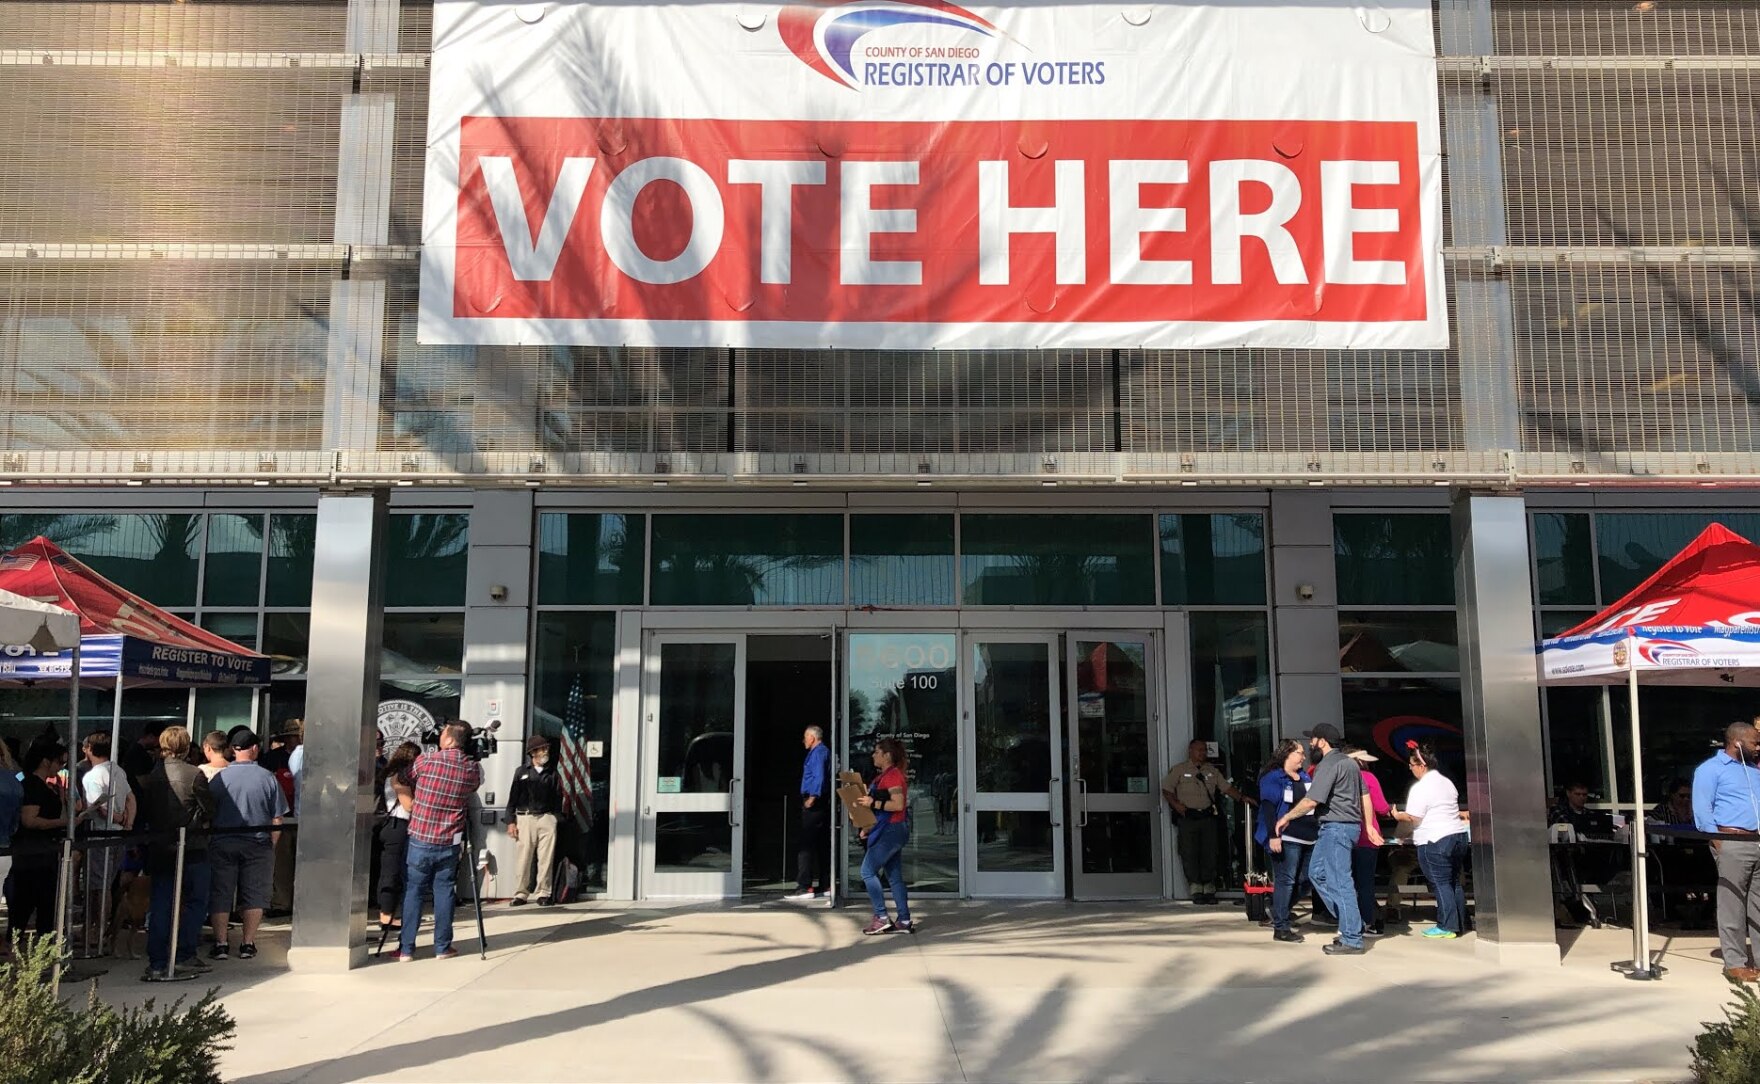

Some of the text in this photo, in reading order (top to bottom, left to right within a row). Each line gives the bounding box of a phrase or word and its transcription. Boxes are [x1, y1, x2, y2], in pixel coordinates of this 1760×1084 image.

[865, 47, 980, 59] COUNTY OF SAN DIEGO
[864, 61, 1106, 86] REGISTRAR OF VOTERS
[478, 156, 1408, 287] VOTE HERE
[152, 646, 253, 671] REGISTER TO VOTE
[1662, 657, 1740, 666] REGISTRAR OF VOTERS
[911, 675, 938, 690] 100
